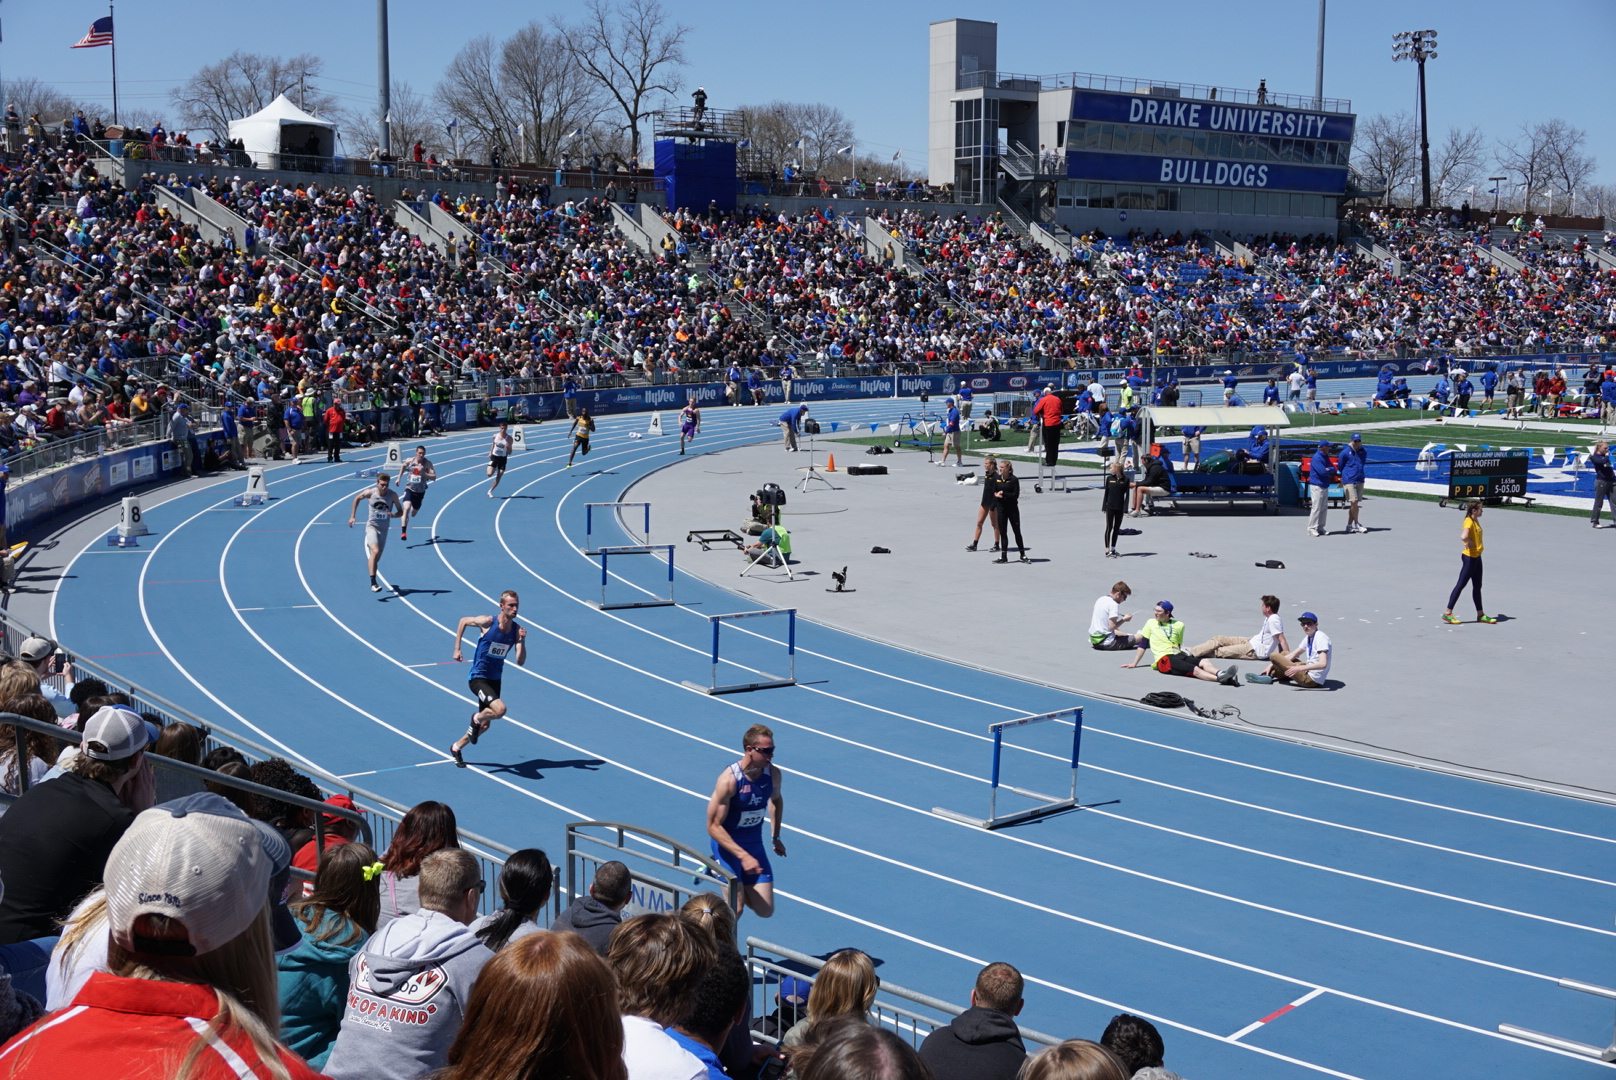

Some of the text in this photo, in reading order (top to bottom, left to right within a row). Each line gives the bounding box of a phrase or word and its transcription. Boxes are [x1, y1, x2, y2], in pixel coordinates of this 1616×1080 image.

[1129, 99, 1327, 138] DRAKE UNIVERSITY
[1160, 159, 1269, 188] BULLDOGS
[793, 381, 824, 397] HyVee
[860, 380, 891, 395] HyVee
[645, 389, 675, 405] HyVee
[652, 417, 659, 428] 4
[514, 431, 522, 442] 5
[389, 448, 398, 462] 6
[1454, 459, 1501, 468] JANAE MOFFITT
[252, 475, 260, 489] 7
[1495, 484, 1521, 494] 5-05.00
[1454, 485, 1485, 496] P P P
[131, 506, 141, 523] 8
[138, 892, 162, 905] Since
[359, 999, 378, 1015] OF
[377, 1004, 387, 1018] A
[389, 1006, 429, 1025] KIND
